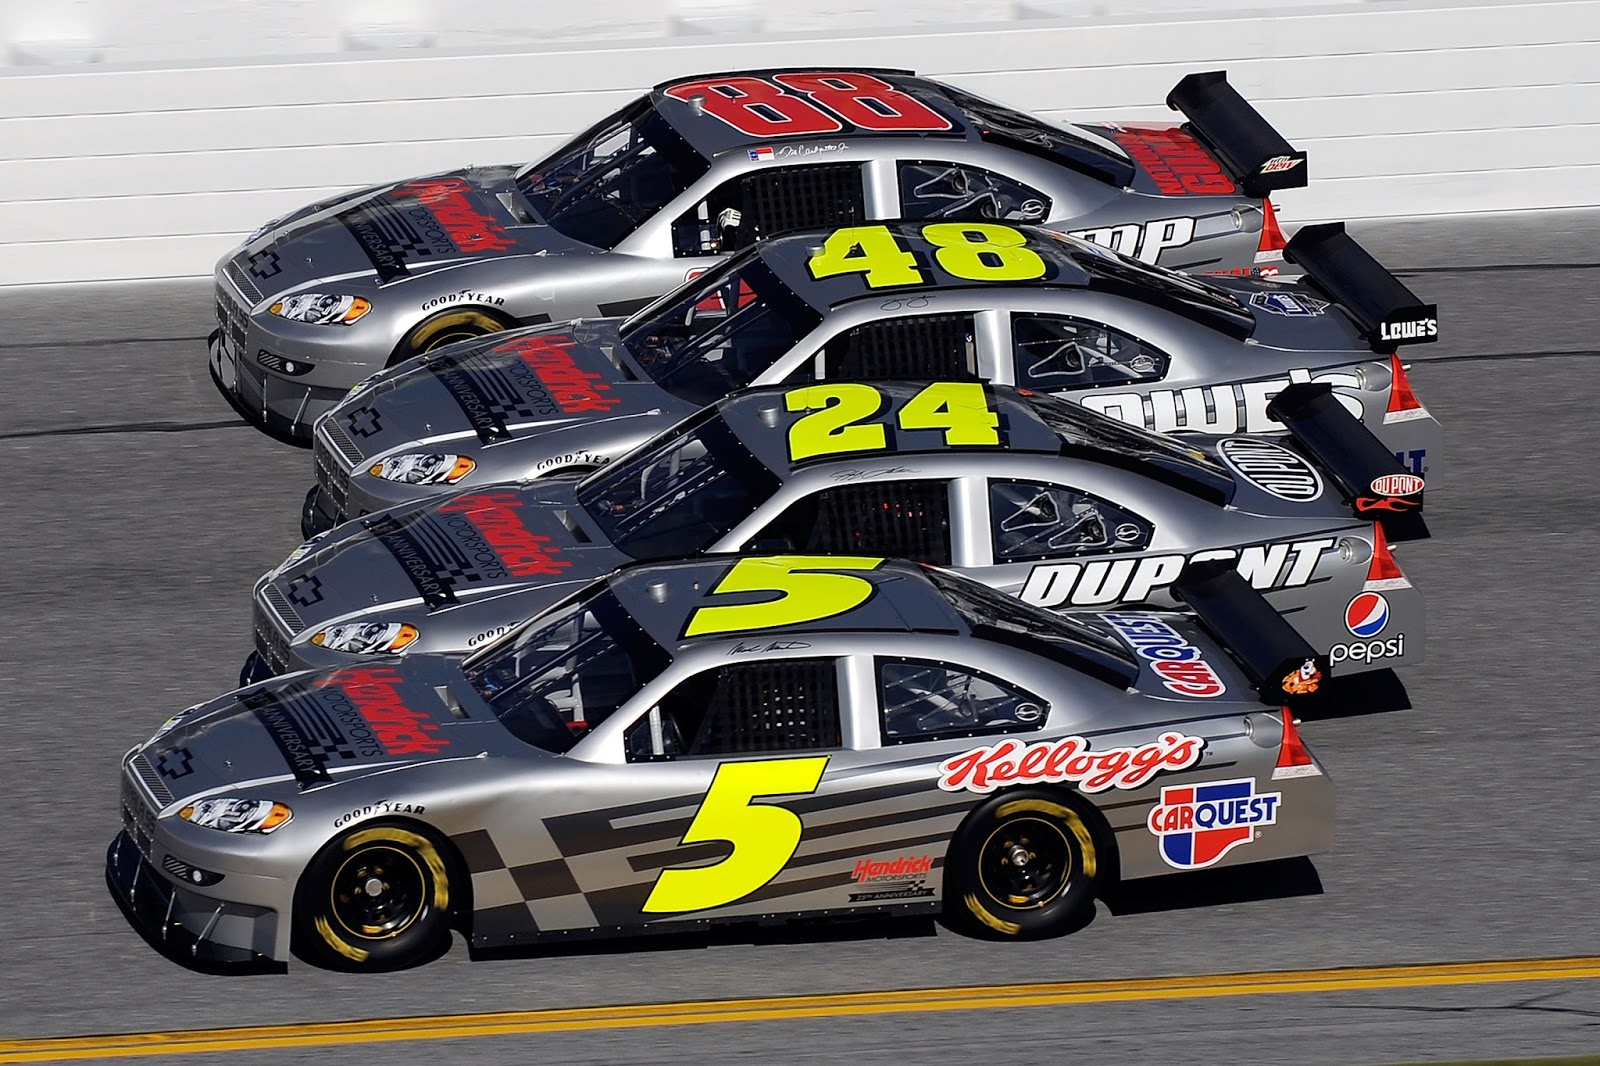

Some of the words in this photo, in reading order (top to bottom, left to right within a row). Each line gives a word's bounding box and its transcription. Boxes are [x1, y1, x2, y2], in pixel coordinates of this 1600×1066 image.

[663, 73, 952, 137] 88
[807, 222, 1047, 288] 48
[421, 291, 505, 311] GOODYEAR
[1381, 318, 1437, 340] LOWE'S
[444, 370, 495, 431] ANNIVERSARY
[492, 335, 621, 413] Hendrick
[785, 382, 999, 461] 24
[386, 534, 444, 598] ANNIVERSARY
[436, 493, 573, 576] Hendrick
[441, 512, 508, 579] MOTORSPORTS
[684, 555, 886, 637] 5
[1021, 540, 1334, 606] DUPNT
[1101, 614, 1224, 696] CARQUEST
[1330, 635, 1404, 664] pepsi
[261, 705, 317, 772] ANNIVERSARY
[313, 667, 450, 755] Hendrick
[320, 686, 383, 757] MOTORSPORTS
[942, 733, 1199, 790] Kellogg's
[333, 802, 426, 828] GOODYEAR
[641, 755, 831, 913] 5
[1151, 796, 1278, 831] CARQUEST
[852, 855, 934, 883] Hendrick
[873, 890, 927, 899] ANNIVERSARY
